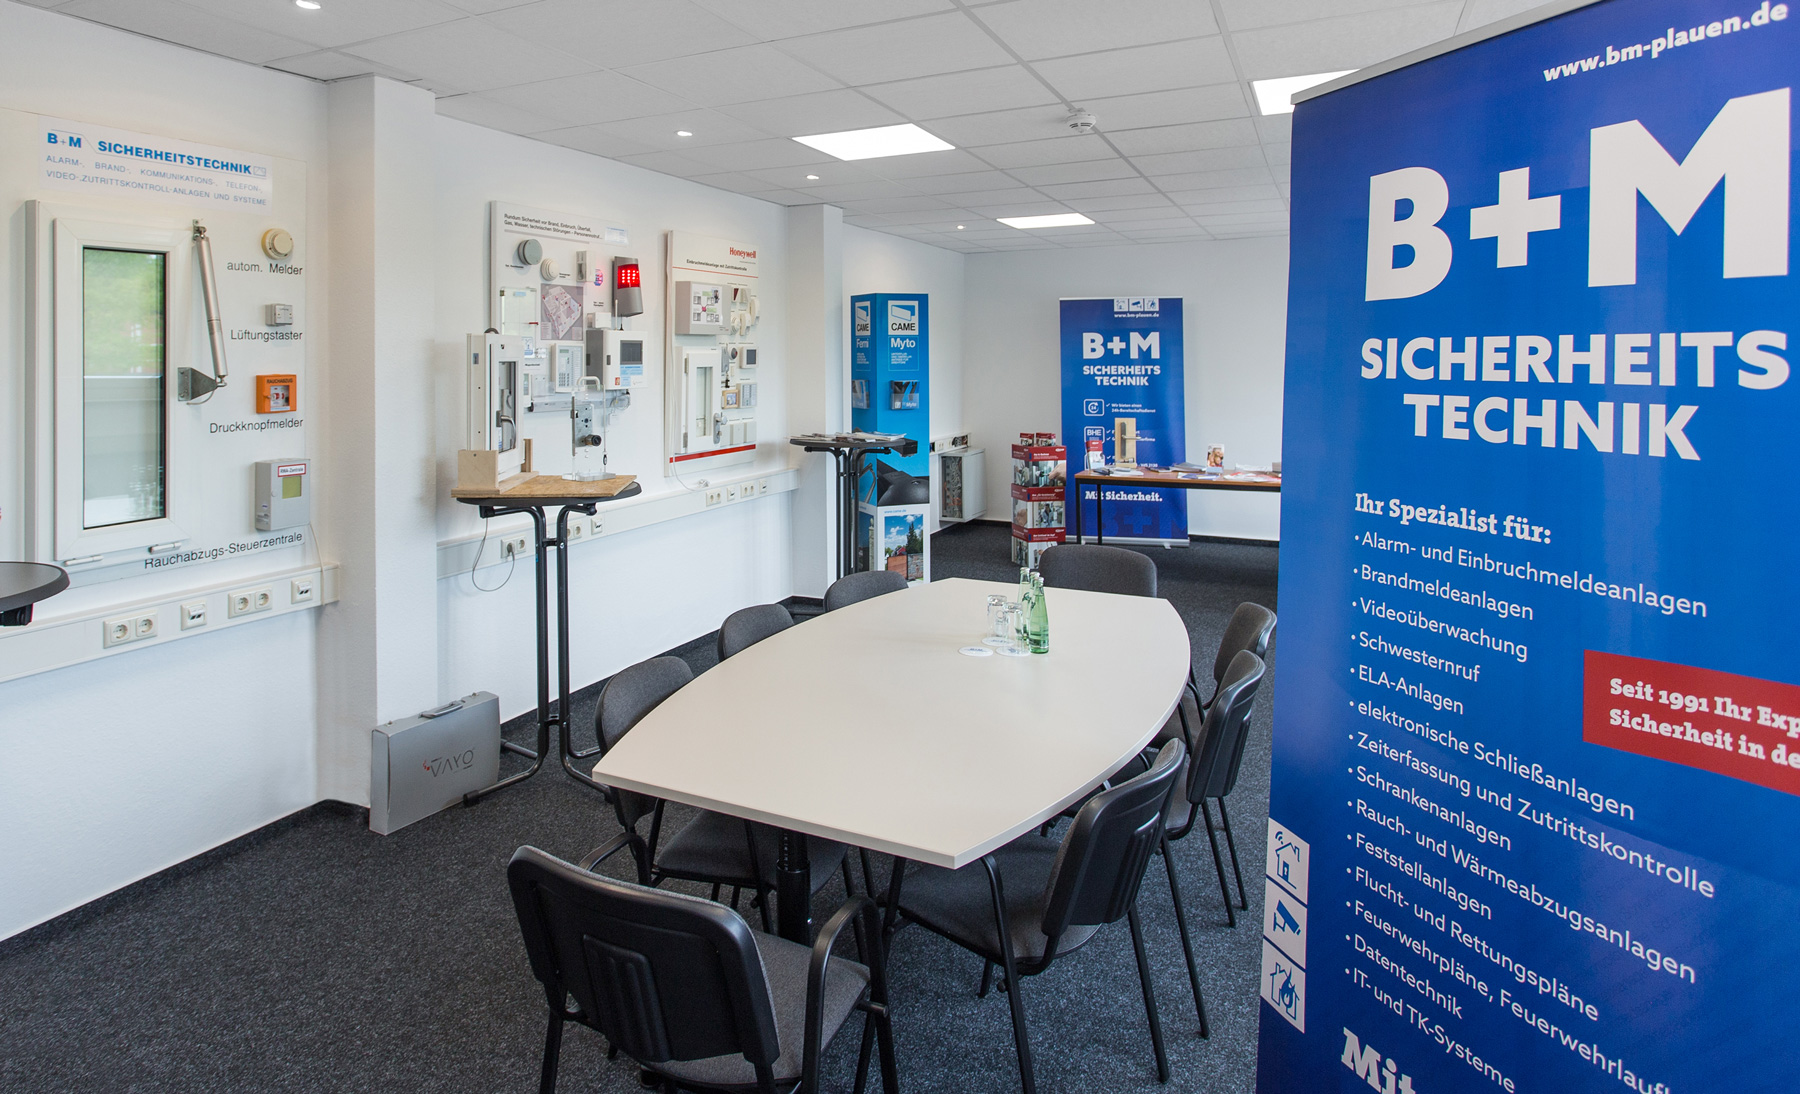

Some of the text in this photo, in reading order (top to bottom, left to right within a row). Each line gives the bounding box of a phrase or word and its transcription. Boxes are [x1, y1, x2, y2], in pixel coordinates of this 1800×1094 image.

[1543, 2, 1789, 81] www.bm-plauen.de
[98, 140, 252, 175] SICHERHEITSTECHNIK
[214, 193, 230, 201] UND
[233, 195, 267, 206] SYSTEME
[521, 216, 541, 224] Sicherheit
[1364, 87, 1790, 302] B+M
[226, 262, 303, 275] autom. Melder
[729, 246, 756, 259] Honeywell
[230, 329, 303, 343] Lüftungstaster
[856, 323, 869, 332] CAME
[890, 322, 916, 331] CAME
[890, 338, 916, 350] Myto
[1082, 331, 1160, 360] B+M
[1082, 365, 1161, 375] SICHERHEITS
[1094, 376, 1149, 386] TECHNIK
[1360, 329, 1791, 390] SICHERHEITS
[209, 418, 304, 434] Druckknopfmelder
[1402, 393, 1701, 460] TECHNIK
[1105, 490, 1163, 502] Sicherheit.
[1354, 492, 1552, 545] Ihr Spezialist für:
[144, 532, 303, 569] Rauchabzugs-Steuerzentrale
[1361, 531, 1707, 618] Alarm- und Einbruchmeldeanlagen
[1361, 563, 1533, 621] Brandmeldeanlagen
[1360, 597, 1528, 663] Videoüberwachung
[1359, 631, 1481, 682] Schwesternruf
[1359, 664, 1464, 715] ELA-Anlagen
[1609, 677, 1654, 701] Seit
[1658, 689, 1710, 713] 1991
[1714, 695, 1752, 722] Ihr
[1609, 708, 1733, 752] Sicherheit
[1737, 734, 1766, 760] in
[1358, 700, 1634, 821] elektronische Schließanlagen
[1357, 765, 1511, 851] Schrankenanlagen
[1357, 731, 1715, 899] Zeiterfassung und Zutrittskontrolle
[1356, 832, 1491, 920] Feststellanlagen
[1357, 798, 1695, 984] Rauch- und Wärmeabzugsanlagen
[1355, 900, 1493, 1003] Feuerwehrpläne,
[1356, 866, 1599, 1021] Flucht- und Rettungspläne
[1355, 934, 1462, 1019] Datentechnik
[1354, 967, 1515, 1094] IT- und TK-Systeme
